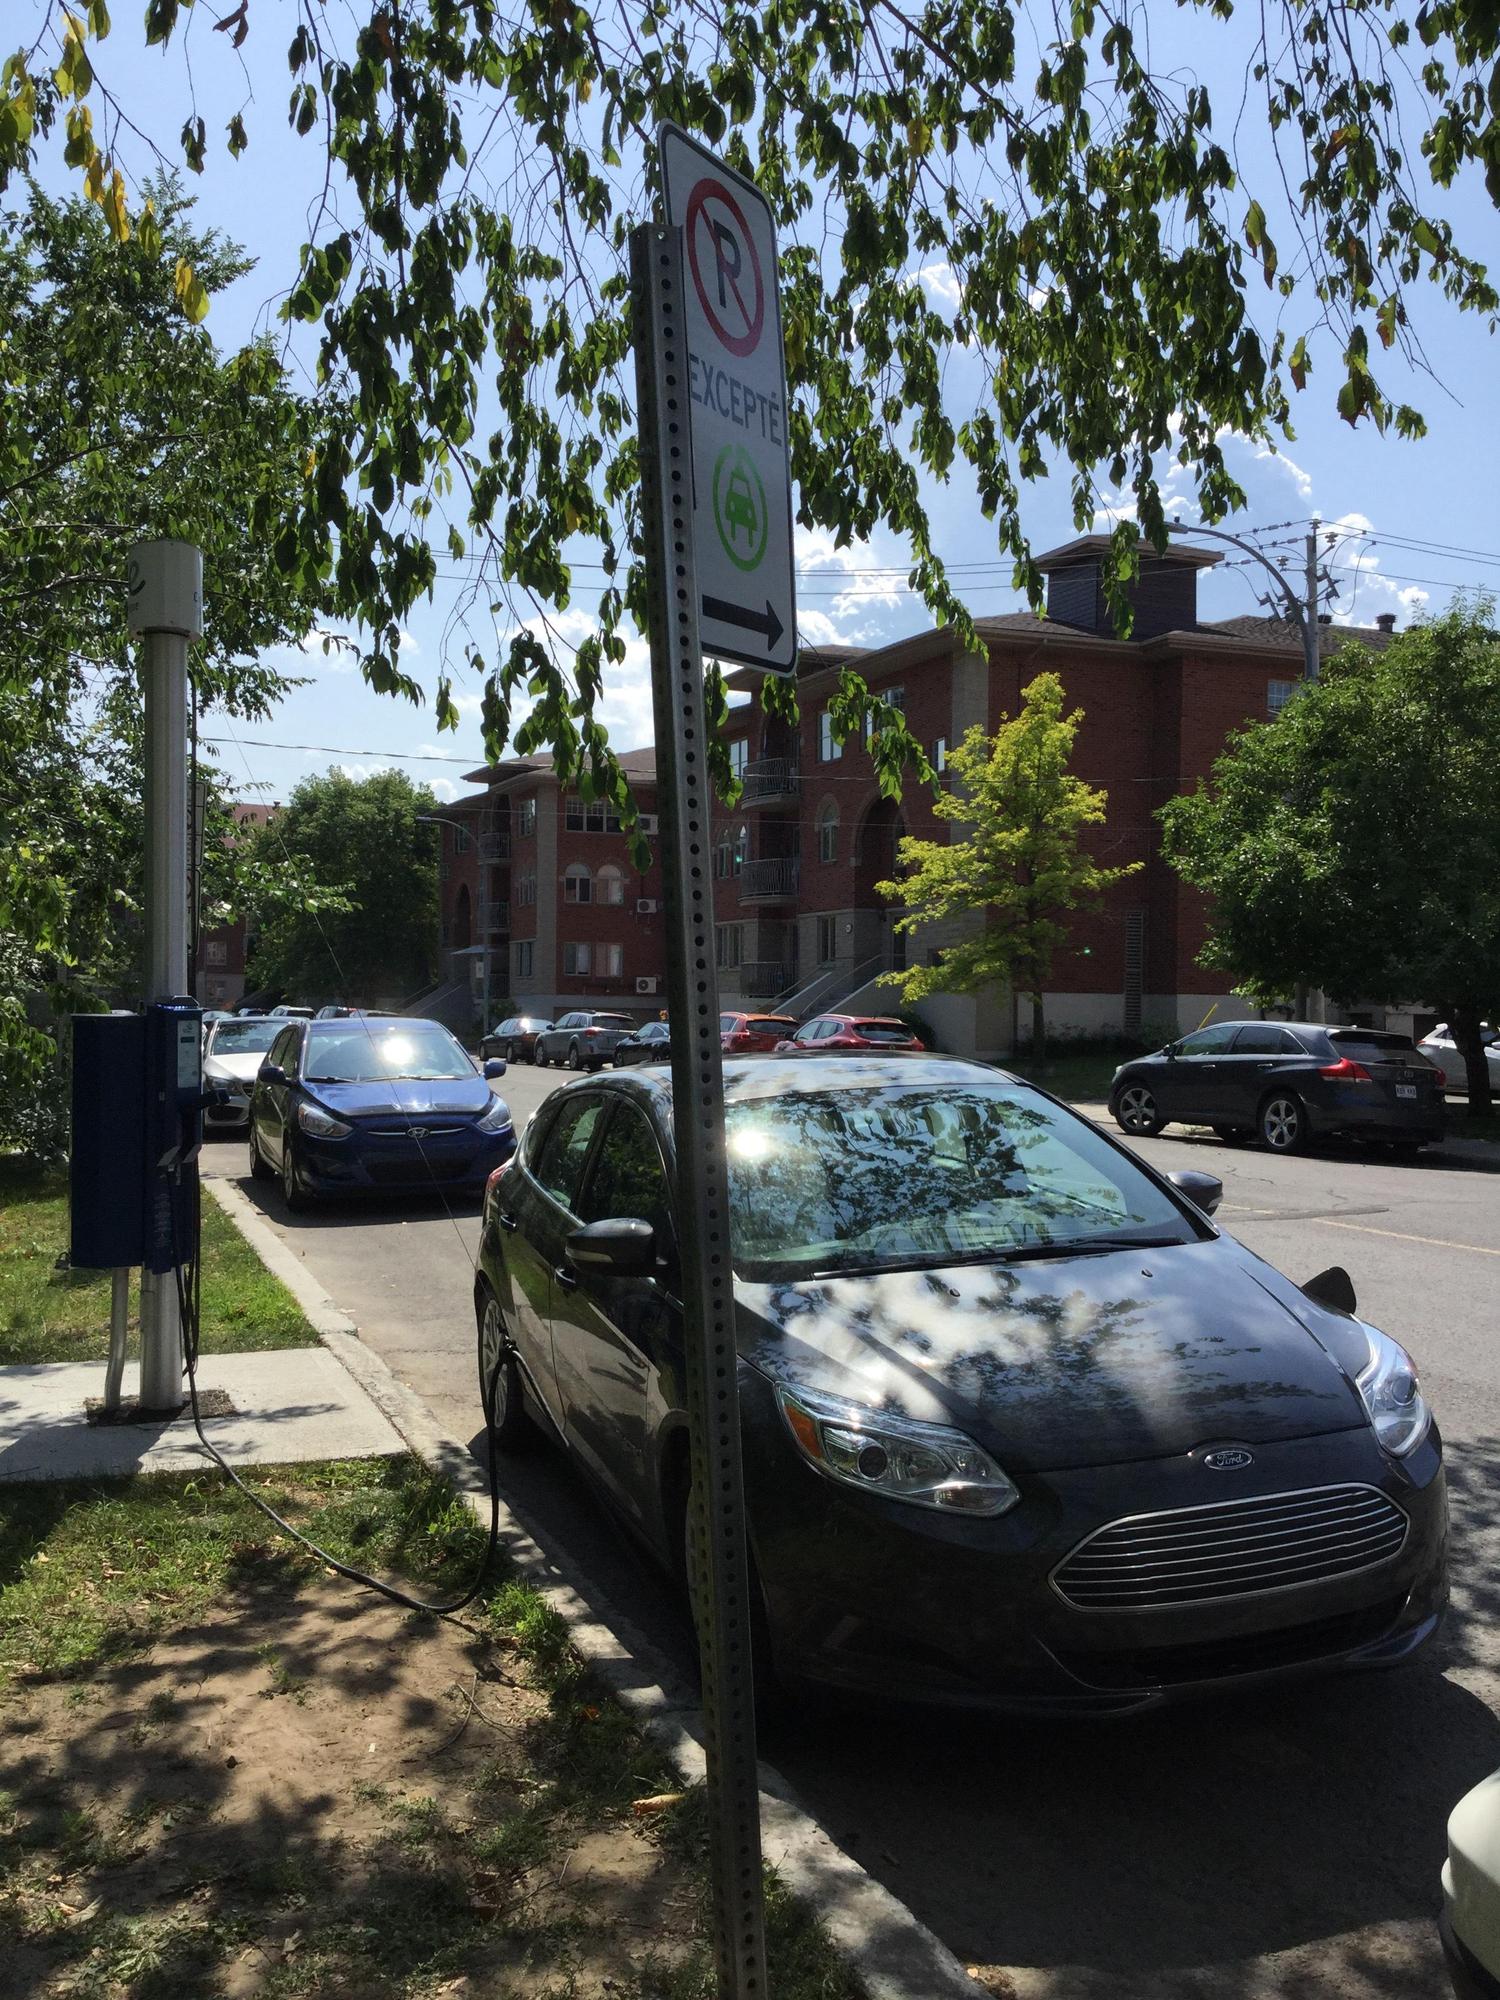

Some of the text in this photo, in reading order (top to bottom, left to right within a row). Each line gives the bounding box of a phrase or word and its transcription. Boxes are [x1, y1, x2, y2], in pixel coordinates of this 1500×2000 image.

[713, 219, 741, 309] P
[689, 353, 783, 447] EXCEPTÉ
[1216, 1452, 1244, 1466] Ford
